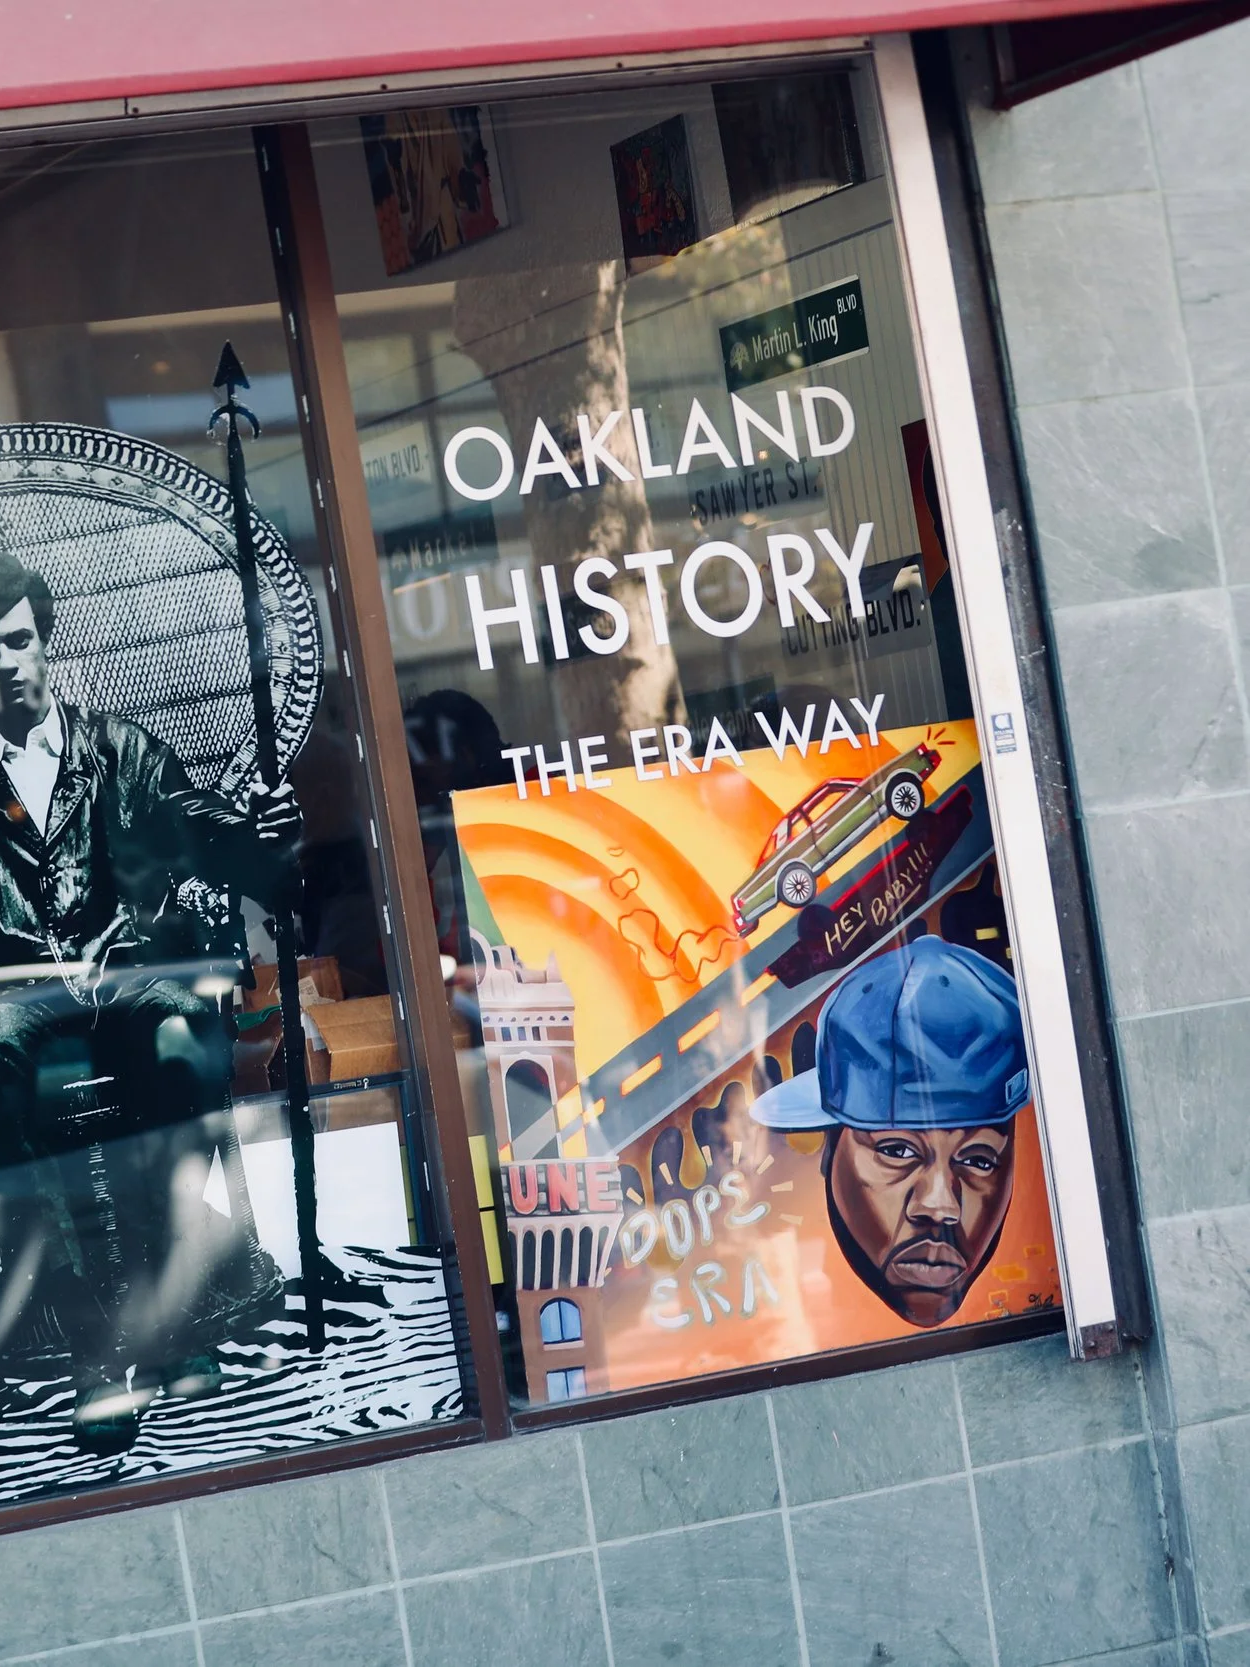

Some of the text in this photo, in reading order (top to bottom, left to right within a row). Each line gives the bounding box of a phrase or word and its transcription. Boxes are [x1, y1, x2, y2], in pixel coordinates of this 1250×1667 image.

[752, 293, 857, 362] Martin L. King BLVD
[364, 457, 390, 488] TON
[444, 386, 856, 501] OAKLAND
[695, 457, 819, 526] SAWYER ST.
[464, 522, 874, 670] HISTORY
[865, 589, 921, 636] BLVD.
[501, 735, 612, 800] THE
[630, 715, 745, 781] ERA
[754, 694, 885, 762] WAY
[825, 902, 864, 957] HEY
[508, 1161, 618, 1216] UNE
[619, 1171, 771, 1269] DOPE
[652, 1257, 780, 1330] ERA
